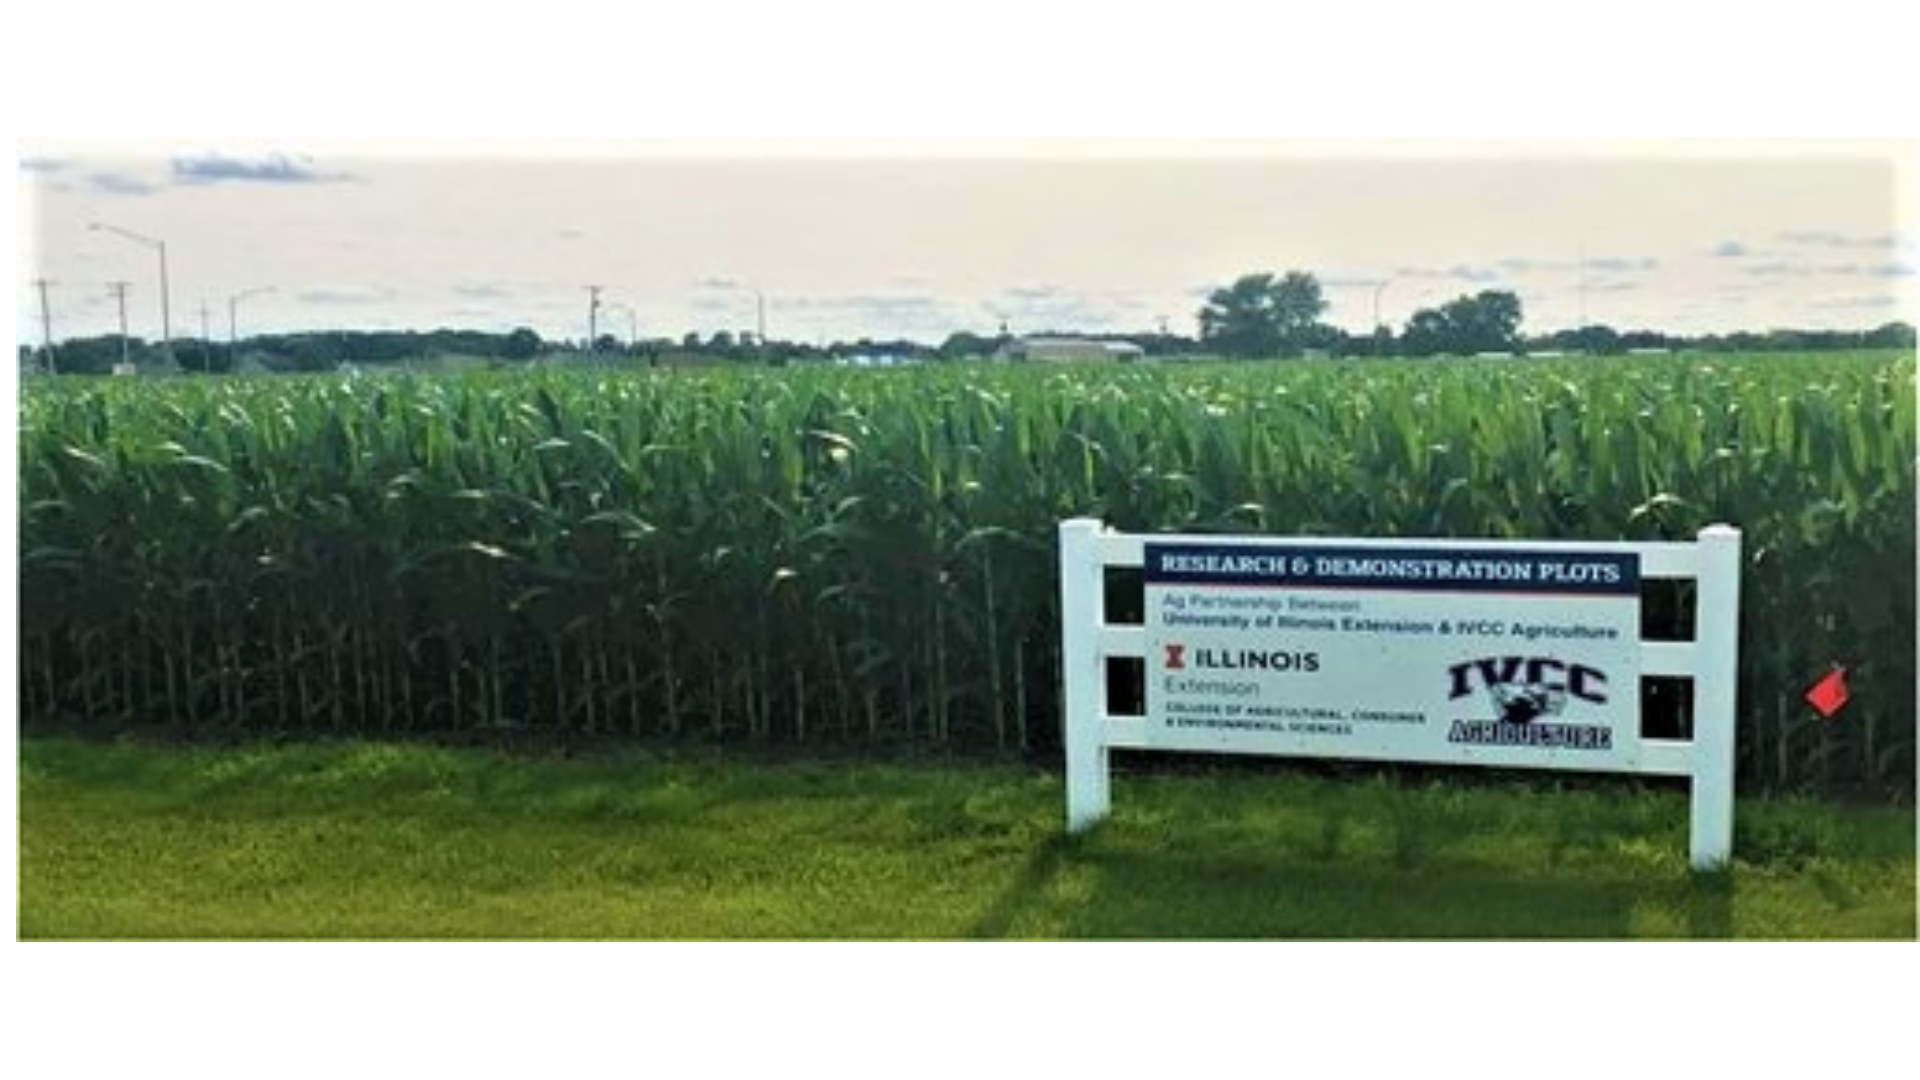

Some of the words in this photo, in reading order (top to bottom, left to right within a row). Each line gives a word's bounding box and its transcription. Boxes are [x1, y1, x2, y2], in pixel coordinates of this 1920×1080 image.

[1161, 555, 1286, 574] RESEARCH
[1315, 558, 1532, 580] DEMONSTRATION
[1538, 562, 1621, 583] PLOTS
[1162, 612, 1249, 630] University
[1255, 615, 1274, 628] of
[1277, 615, 1336, 631] Illinois
[1341, 617, 1434, 633] Extension
[1438, 619, 1452, 634] &
[1456, 620, 1505, 636] IVCC
[1511, 622, 1619, 640] Agriculture
[1195, 649, 1321, 671] ILLINOIS
[1164, 675, 1261, 696] Extension
[1447, 656, 1609, 706] IVCC
